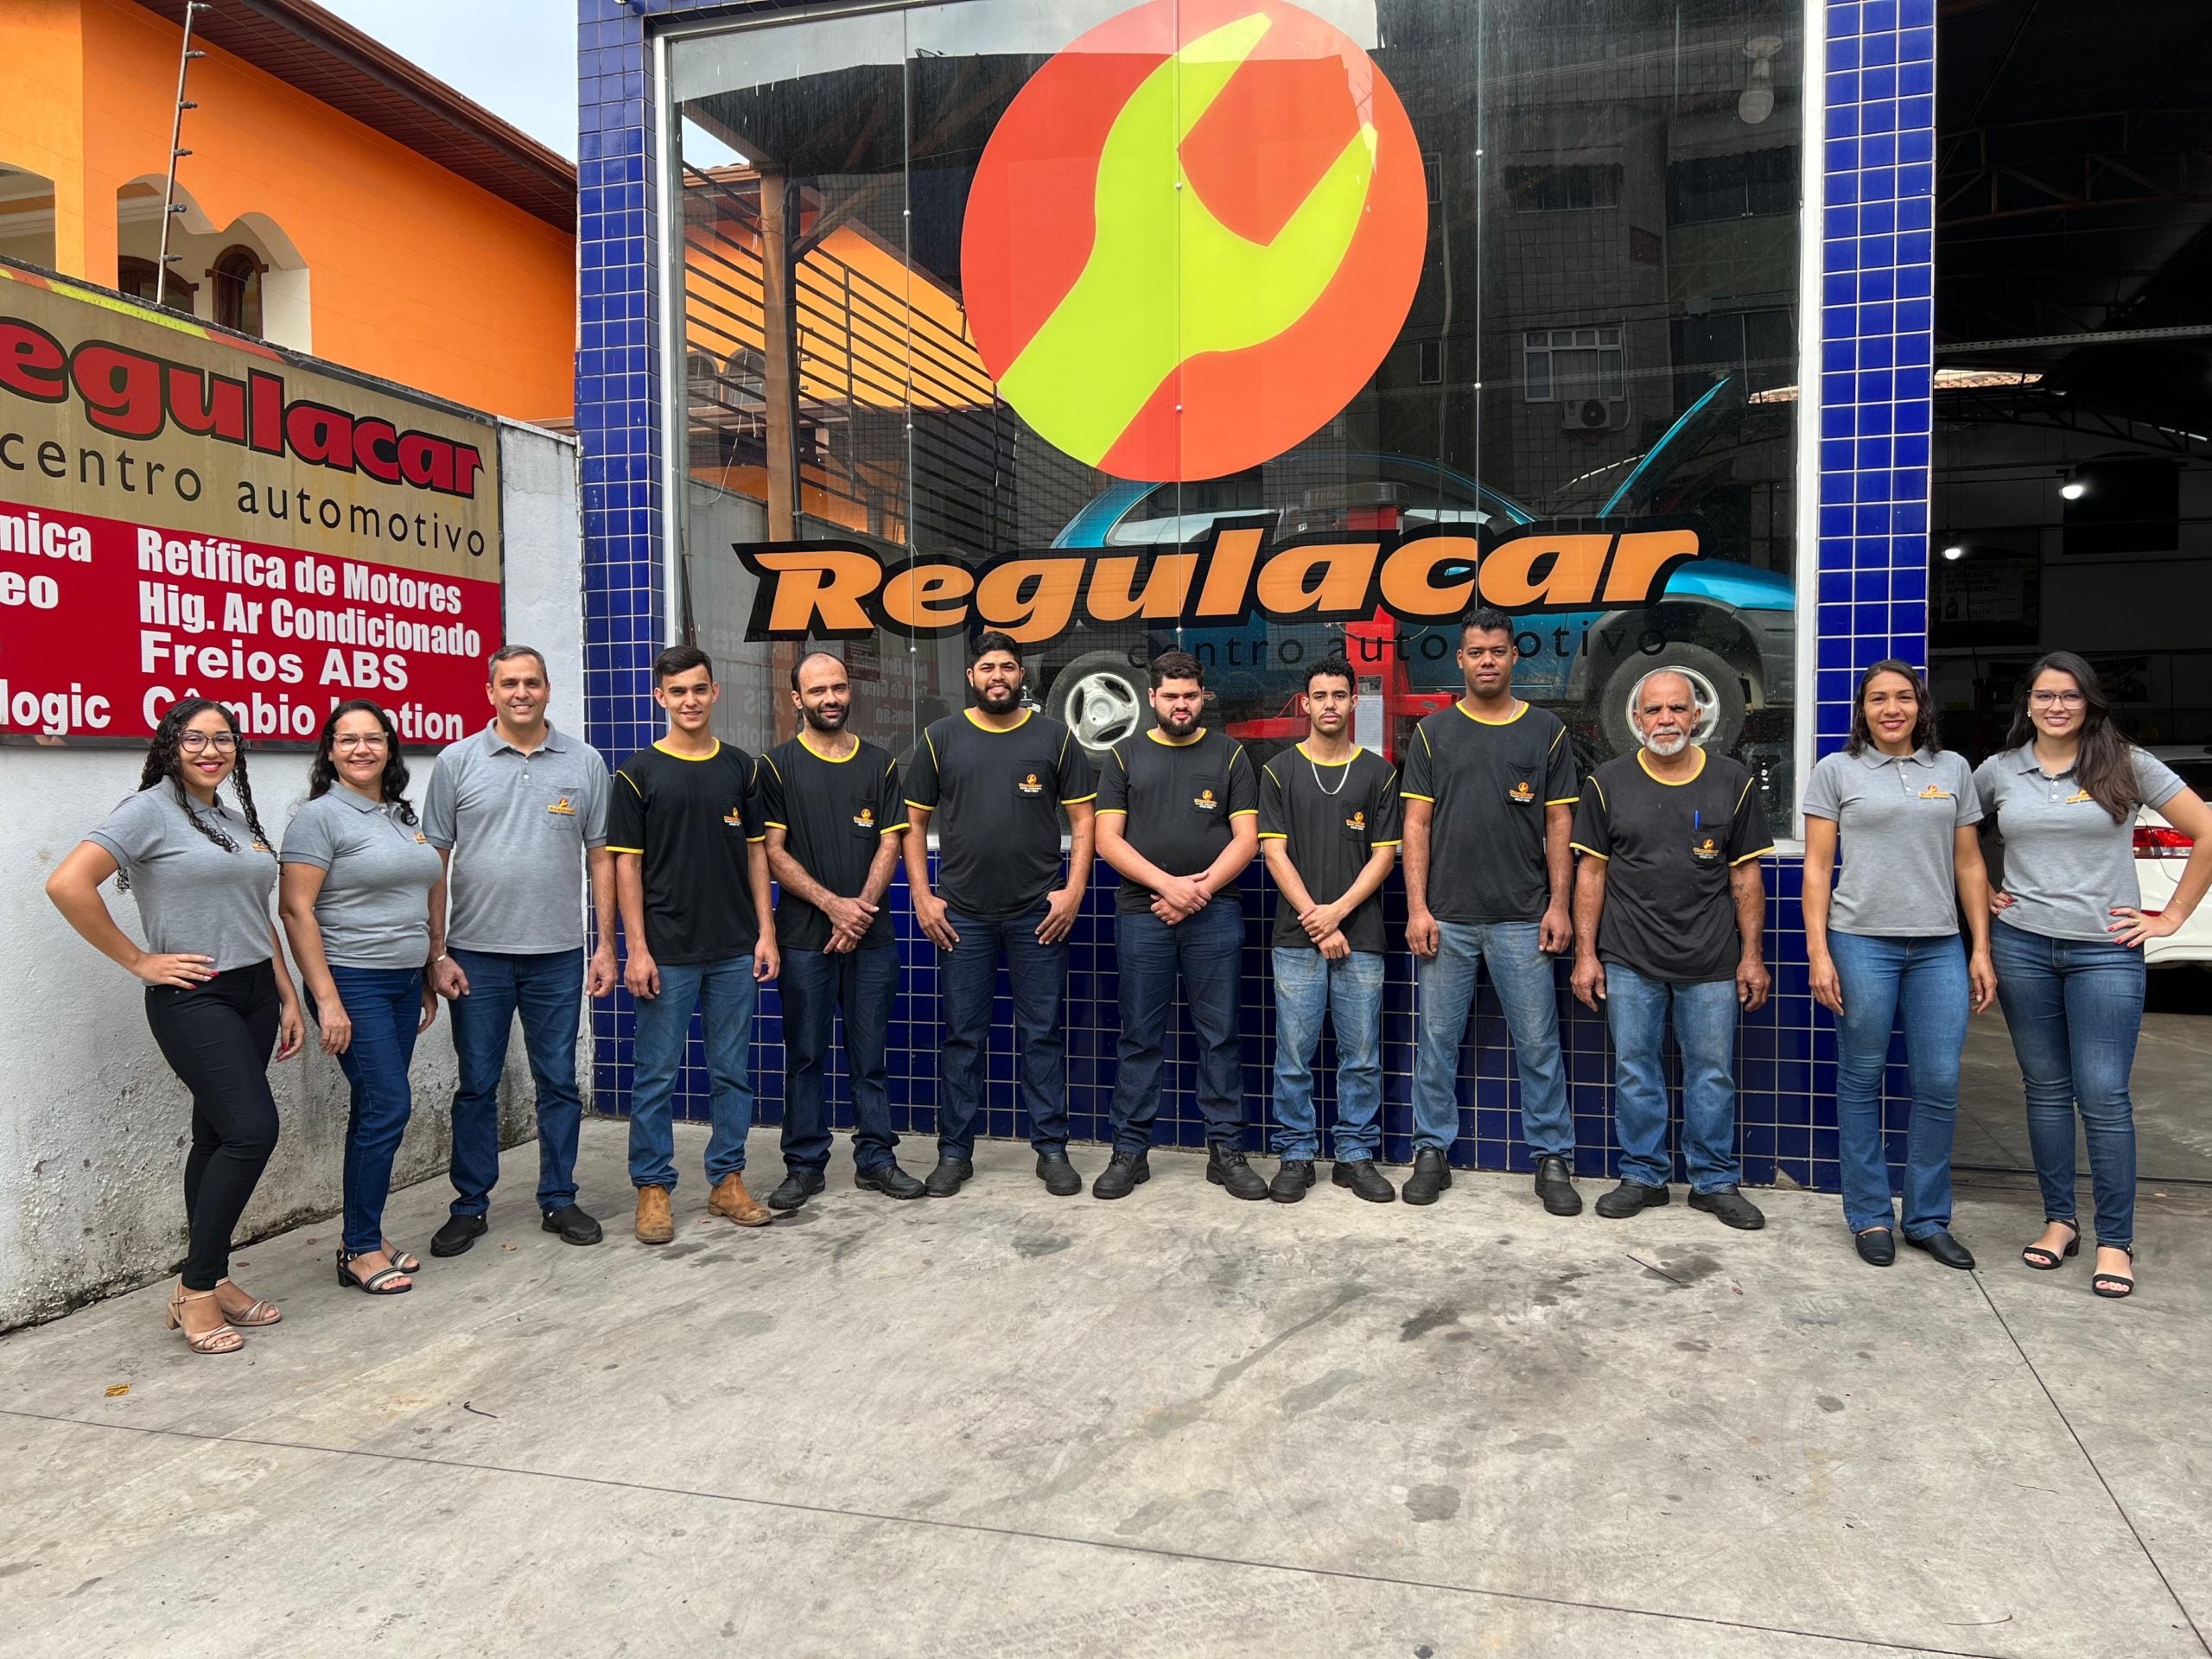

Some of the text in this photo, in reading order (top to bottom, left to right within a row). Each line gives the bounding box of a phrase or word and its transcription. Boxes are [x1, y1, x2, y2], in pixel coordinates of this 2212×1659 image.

[0, 433, 485, 557] centro automotivo
[0, 571, 59, 609] eo
[137, 527, 462, 614] Retífica de Motores
[753, 528, 1700, 643] Regulacar
[138, 580, 480, 658] Hig. Ar Condicionado
[1327, 620, 1665, 664] autootivo
[140, 630, 408, 691] Freios ABS
[0, 678, 111, 735] logic
[143, 685, 315, 735] Cmbio
